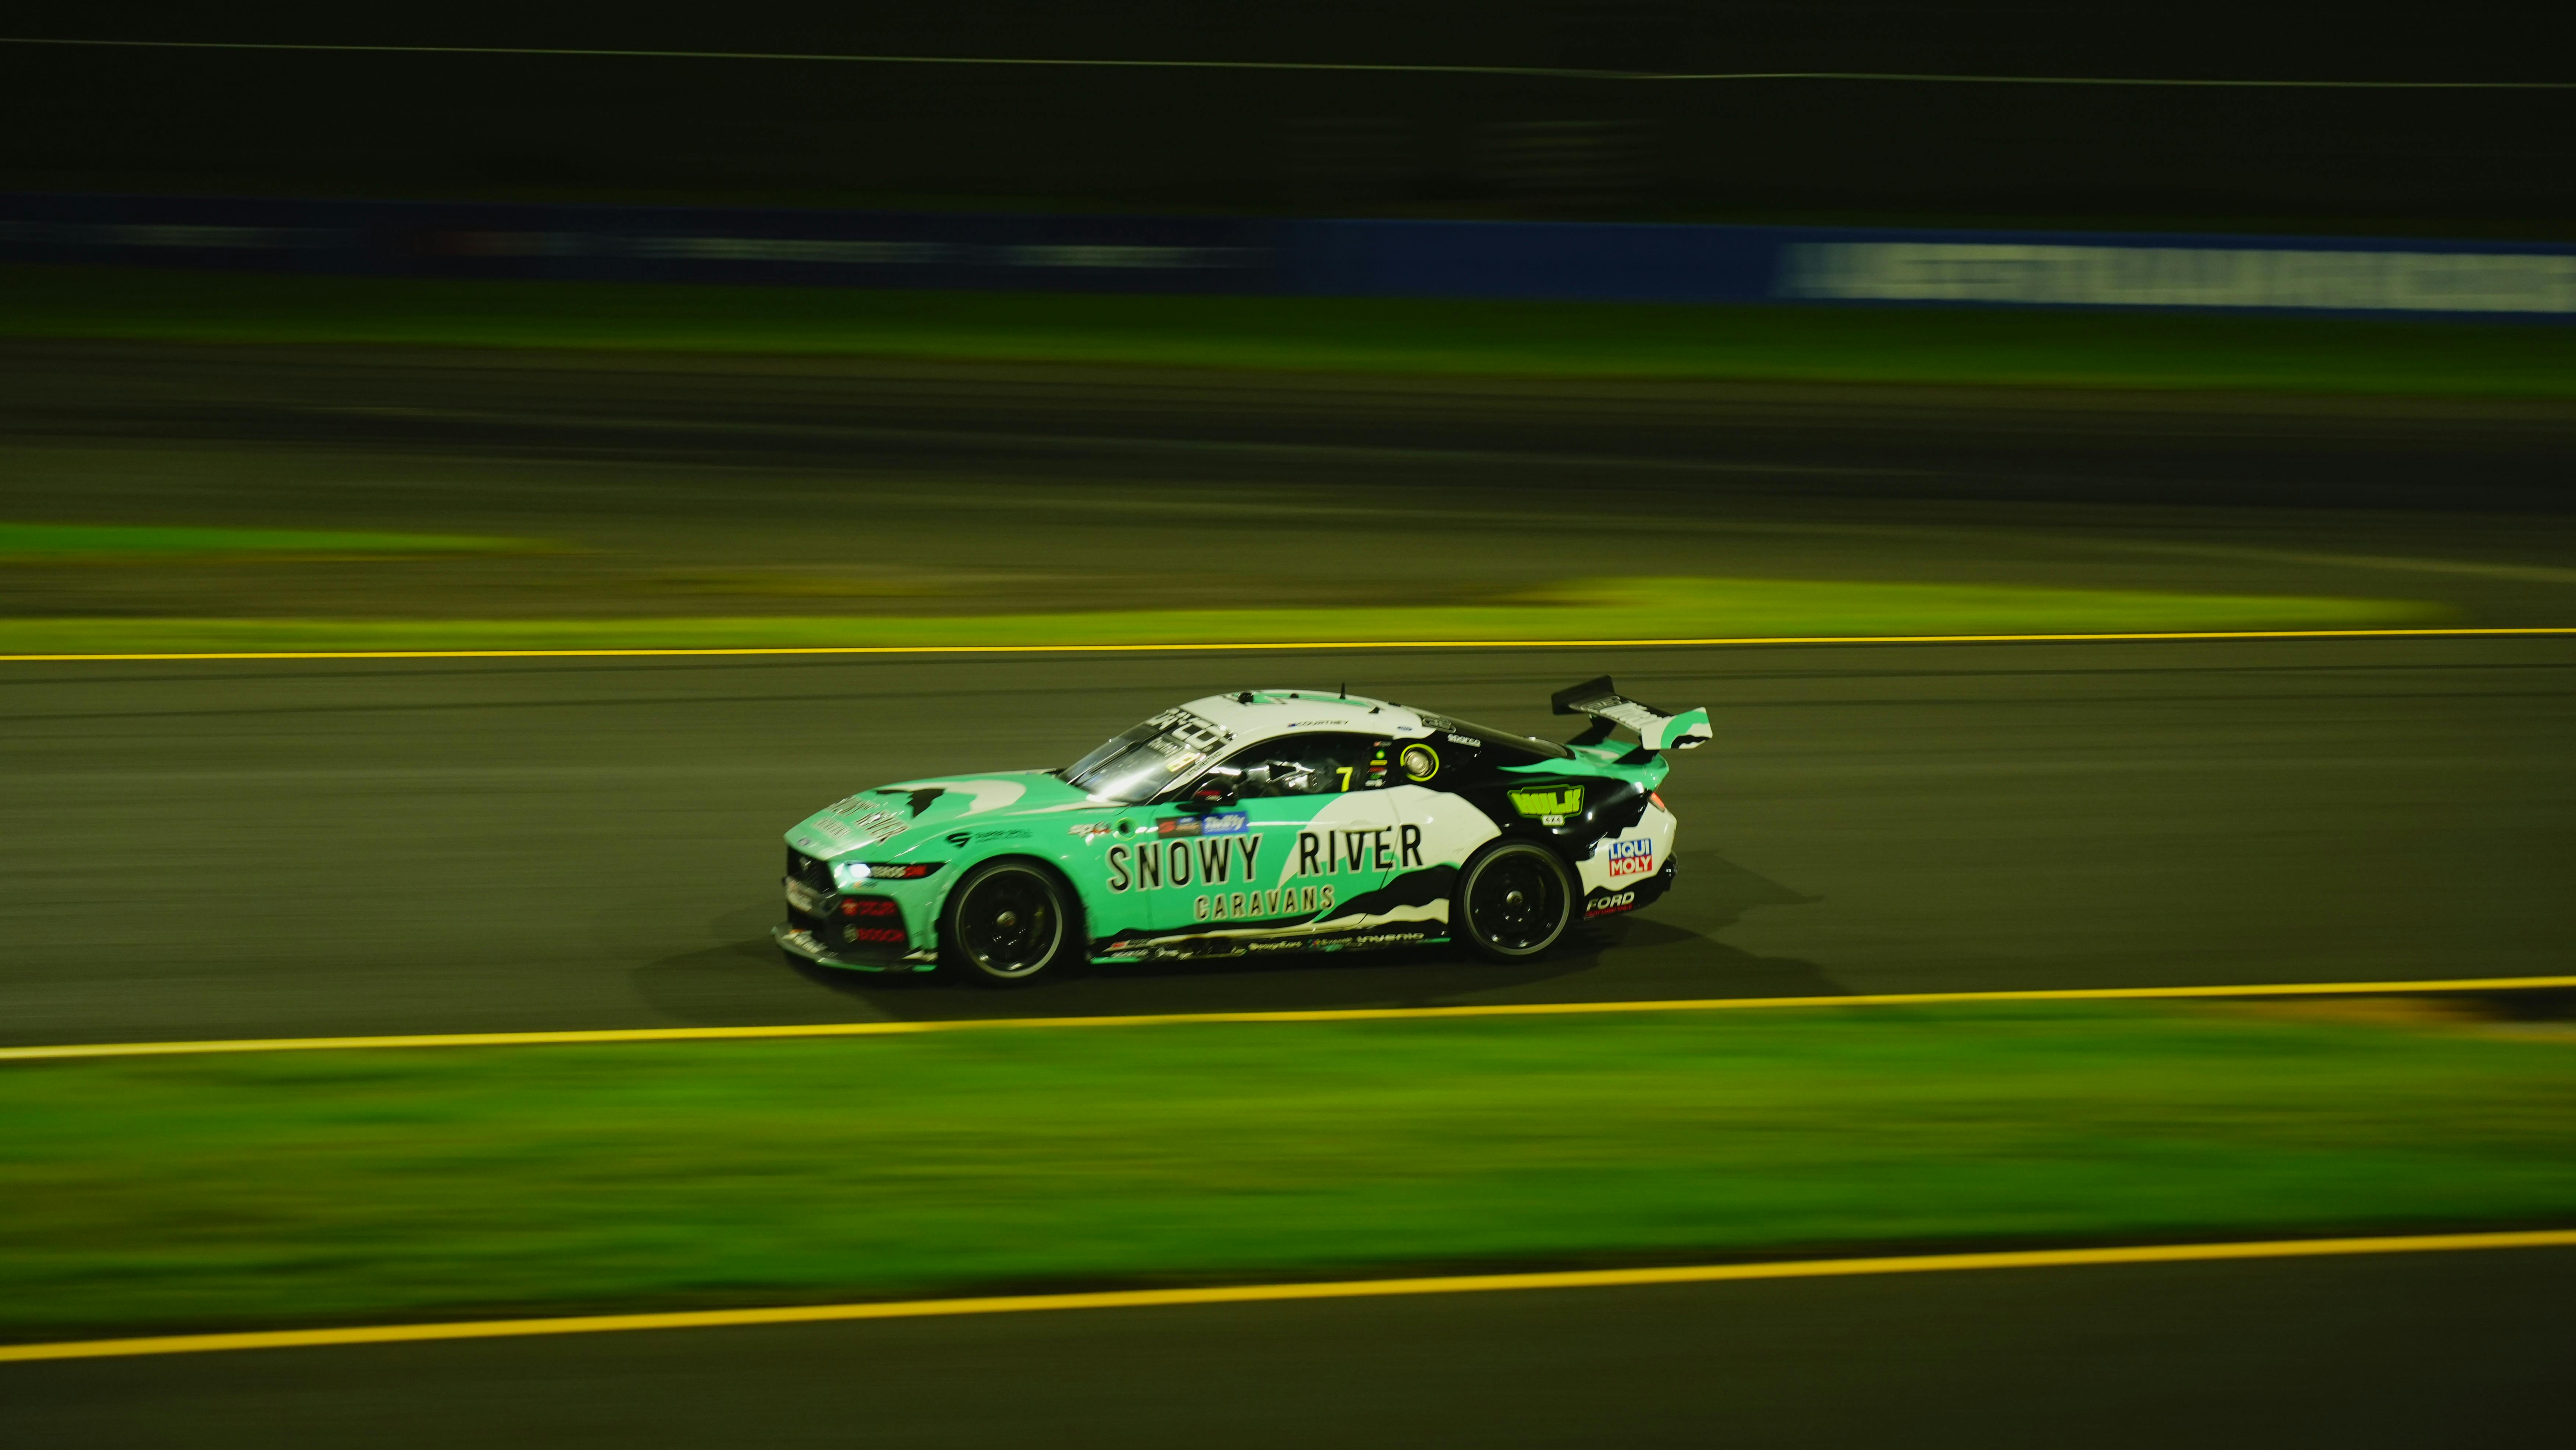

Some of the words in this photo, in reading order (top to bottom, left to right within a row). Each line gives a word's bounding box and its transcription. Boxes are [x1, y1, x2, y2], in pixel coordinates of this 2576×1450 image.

[1336, 767, 1353, 792] 7
[1511, 788, 1581, 815] HULK
[1106, 832, 1263, 894] SNOWY
[1297, 824, 1424, 878] RIVER
[1610, 839, 1650, 859] LIQUI
[1611, 856, 1651, 876] MOLY
[1194, 885, 1335, 921] CARAVANS
[1586, 891, 1635, 911] FORD
